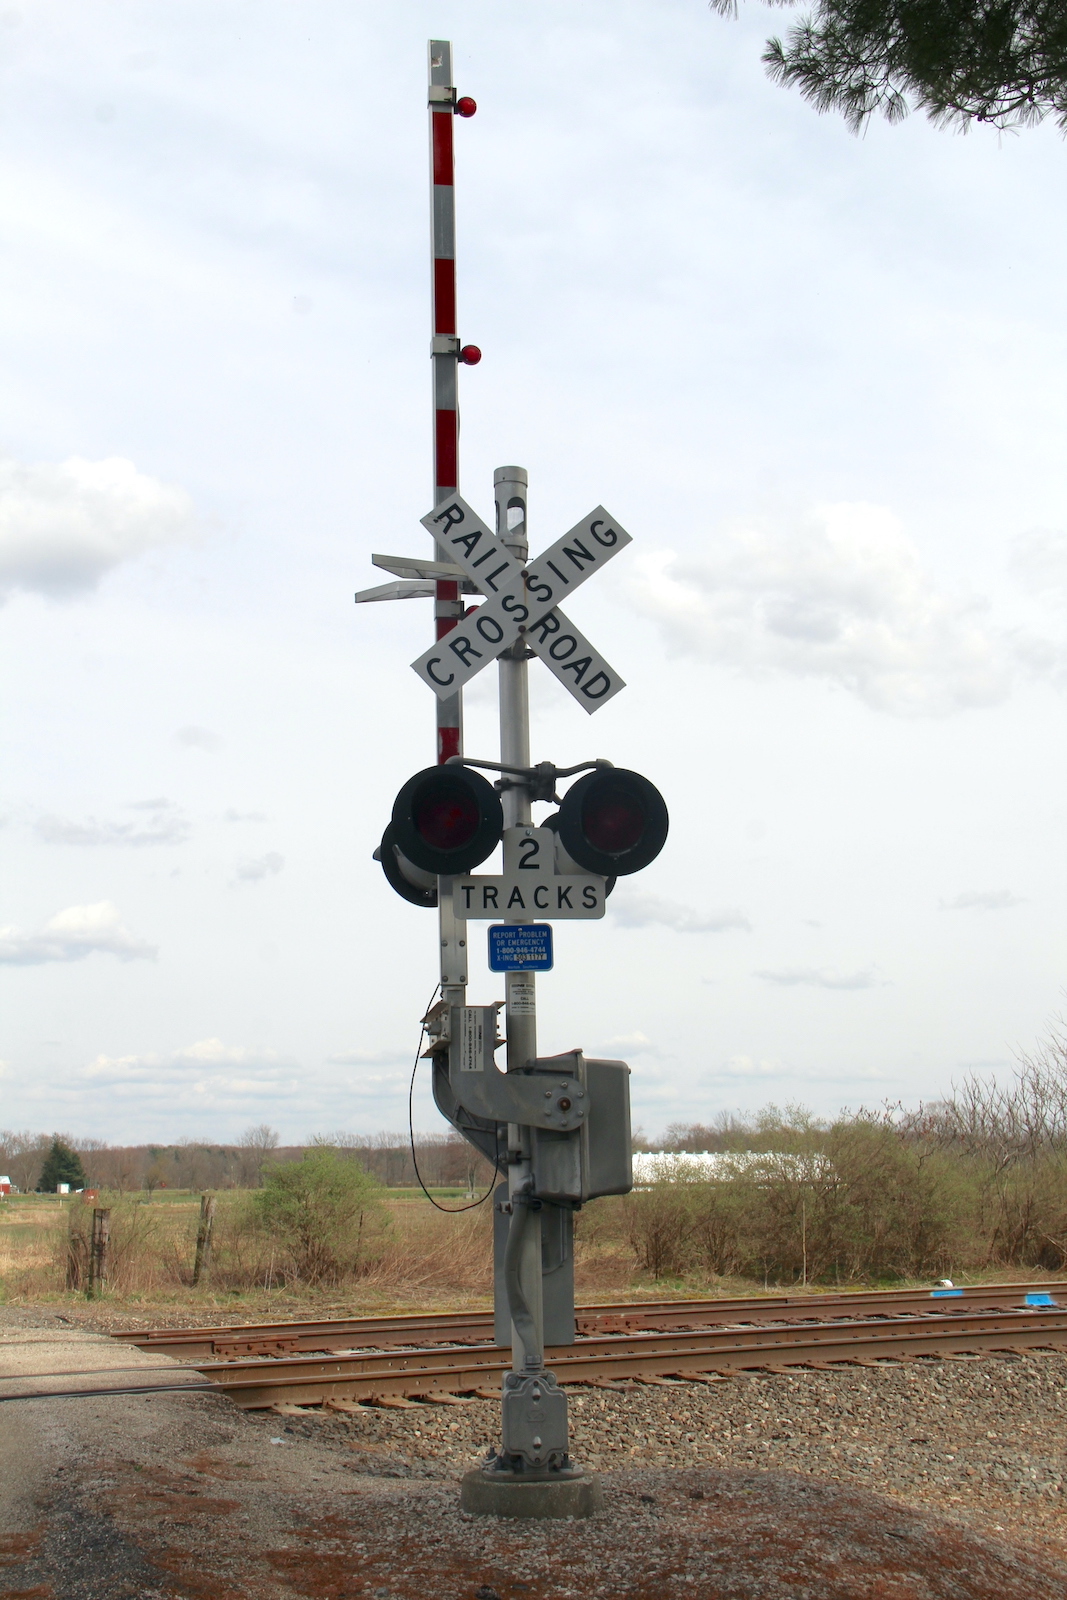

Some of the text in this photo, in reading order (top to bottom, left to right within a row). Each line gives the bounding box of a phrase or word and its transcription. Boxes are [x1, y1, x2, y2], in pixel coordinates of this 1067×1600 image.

[436, 502, 510, 593] RAIL
[426, 519, 618, 686] CROSSING
[529, 612, 611, 699] ROAD
[461, 885, 597, 909] TRACKS
[518, 838, 540, 869] 2
